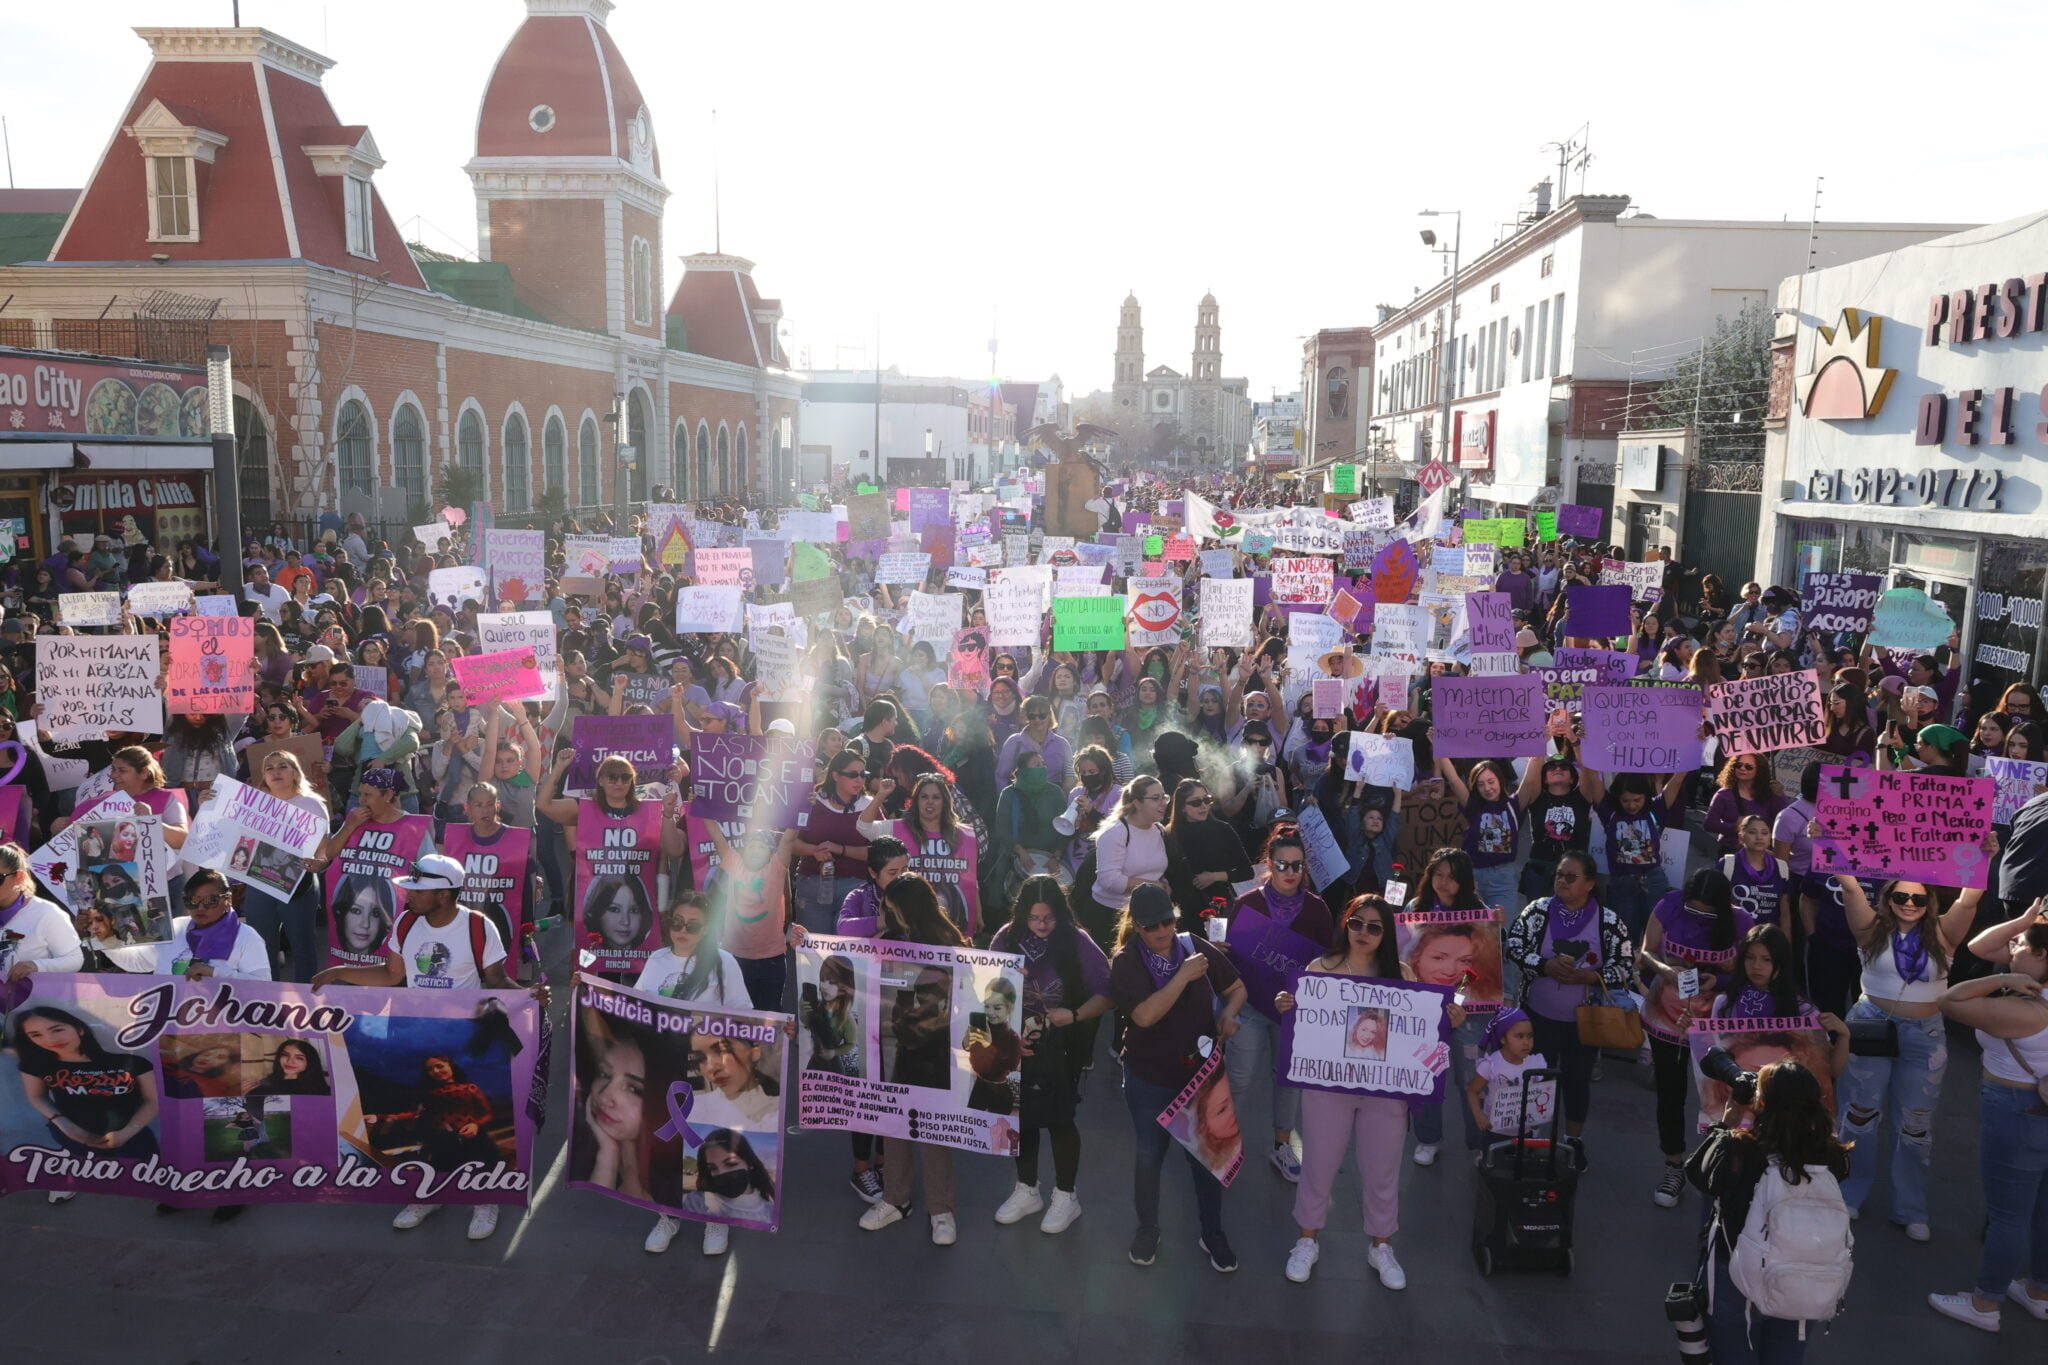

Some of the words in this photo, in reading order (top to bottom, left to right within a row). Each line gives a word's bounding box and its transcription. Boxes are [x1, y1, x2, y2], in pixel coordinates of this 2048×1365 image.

[1926, 272, 2048, 347] PREST
[34, 365, 82, 417] City
[1915, 387, 2015, 446] DEL
[1466, 543, 1494, 553] LIBRE
[489, 549, 543, 566] PARTOS
[1288, 560, 1307, 573] NO
[1467, 554, 1492, 563] VIVA
[697, 564, 709, 572] NO
[712, 563, 719, 571] TE
[1625, 563, 1659, 575] SOMOS
[1614, 573, 1643, 582] GRITO
[1810, 574, 1829, 586] NO
[1830, 574, 1852, 588] ES
[1056, 599, 1074, 614] SOY
[1079, 599, 1089, 614] LA
[1472, 594, 1512, 621] Vivas
[1801, 600, 1814, 613] ES
[1813, 588, 1876, 610] PIROPO
[1148, 604, 1166, 617] NO
[500, 614, 526, 627] SOLO
[1808, 613, 1868, 633] ACOSO
[484, 629, 526, 644] Quiero
[530, 628, 549, 645] que
[1383, 630, 1400, 640] NO
[1404, 631, 1416, 640] TE
[1472, 624, 1512, 650] Libres
[50, 641, 78, 662] POR
[100, 643, 152, 662] MAMÁ
[201, 637, 225, 656] el
[1472, 656, 1487, 672] SIN
[1490, 655, 1520, 673] MIEDO
[1607, 652, 1627, 673] las
[38, 663, 58, 682] POR
[87, 662, 148, 681] ABUELA
[1560, 668, 1598, 683] era
[647, 677, 670, 690] NO
[1739, 671, 1805, 693] cansas
[39, 685, 59, 704] POR
[86, 681, 156, 700] HERMANA
[171, 688, 187, 698] DE
[192, 687, 211, 697] LAS
[1658, 694, 1700, 706] VOLVER
[62, 700, 87, 714] POR
[1450, 711, 1469, 723] por
[1478, 707, 1531, 721] AMOR
[1712, 700, 1820, 730] NOSOTRAS
[47, 713, 77, 728] POR
[78, 707, 135, 727] TODAS
[1616, 710, 1657, 726] CASA
[1437, 728, 1458, 738] NO
[1465, 727, 1483, 739] por
[1607, 730, 1635, 741] CON
[1644, 732, 1660, 740] MI
[1717, 730, 1742, 754] DE
[1744, 719, 1826, 751] VIVIRLO
[696, 735, 745, 756] LAS
[592, 747, 658, 764] JUSTICIA
[697, 755, 745, 781] NO
[758, 758, 798, 784] SE
[1989, 759, 2032, 780] VINE
[697, 779, 790, 806] TOCAN
[1879, 774, 1902, 791] Me
[1909, 776, 1947, 792] Falta
[1950, 779, 1974, 796] mi
[102, 798, 133, 814] mas
[235, 783, 260, 808] NI
[258, 793, 290, 822] UNA
[288, 807, 321, 836] MAS
[1900, 793, 1965, 809] PRIMA
[1816, 800, 1871, 821] Georgina
[1915, 811, 1927, 824] a
[1931, 810, 1985, 829] Mexico
[281, 824, 310, 850] VIVE
[358, 830, 395, 851] NO
[605, 828, 638, 848] NO
[1911, 827, 1965, 843] Faltan
[139, 818, 159, 895] JOHANA
[341, 848, 358, 861] ME
[360, 849, 405, 868] OLVIDEN
[586, 849, 603, 862] ME
[607, 849, 650, 862] OLVIDEN
[1900, 846, 1947, 862] MILES
[342, 861, 376, 876] FALTO
[377, 865, 393, 879] YO
[464, 854, 498, 876] NO
[594, 863, 625, 876] FALTO
[628, 864, 642, 876] YO
[924, 859, 967, 870] OLVIDEN
[944, 873, 959, 884] YO
[488, 892, 504, 903] YO
[1398, 908, 1490, 924] DESAPARECIDA
[800, 938, 848, 952] JUSTICIA
[849, 942, 879, 956] PARA
[880, 945, 918, 960] JACIVI,
[918, 949, 936, 962] NO
[937, 951, 953, 963] TE
[955, 953, 1022, 970] OLVIDAMOS
[1303, 977, 1329, 1000] NO
[1340, 982, 1414, 1013] ESTAMOS
[116, 983, 353, 1050] Johana
[580, 983, 653, 1026] Justicia
[656, 1012, 693, 1034] por
[697, 1014, 777, 1045] Johana
[1296, 1007, 1347, 1027] TODAS
[1388, 1012, 1427, 1039] FALTA
[1699, 1016, 1814, 1032] DESAPARECIDA
[1292, 1056, 1342, 1083] FABIOLA
[1343, 1061, 1383, 1086] ANAHI
[802, 1072, 824, 1082] PARA
[826, 1074, 861, 1089] ASESINAR
[870, 1082, 911, 1096] VULNERAR
[802, 1083, 812, 1093] EL
[814, 1084, 844, 1096] CUERPO
[802, 1094, 842, 1106] CONDICIÓN
[843, 1098, 858, 1109] QUE
[859, 1101, 905, 1117] ARGUMENTA
[802, 1105, 814, 1115] NO
[815, 1107, 826, 1116] LO
[863, 1112, 880, 1123] HAY
[918, 1110, 933, 1121] NO
[934, 1112, 991, 1130] PRIVILEGIOS.
[919, 1121, 941, 1132] PISO
[942, 1124, 977, 1138] PAREJO.
[919, 1130, 962, 1145] CONDENA
[962, 1136, 991, 1151] JUSTA.
[131, 1153, 282, 1193] derecho
[293, 1164, 328, 1188] a
[335, 1153, 380, 1190] la
[391, 1159, 530, 1200] Vida
[1523, 1222, 1561, 1232] MONSTER
